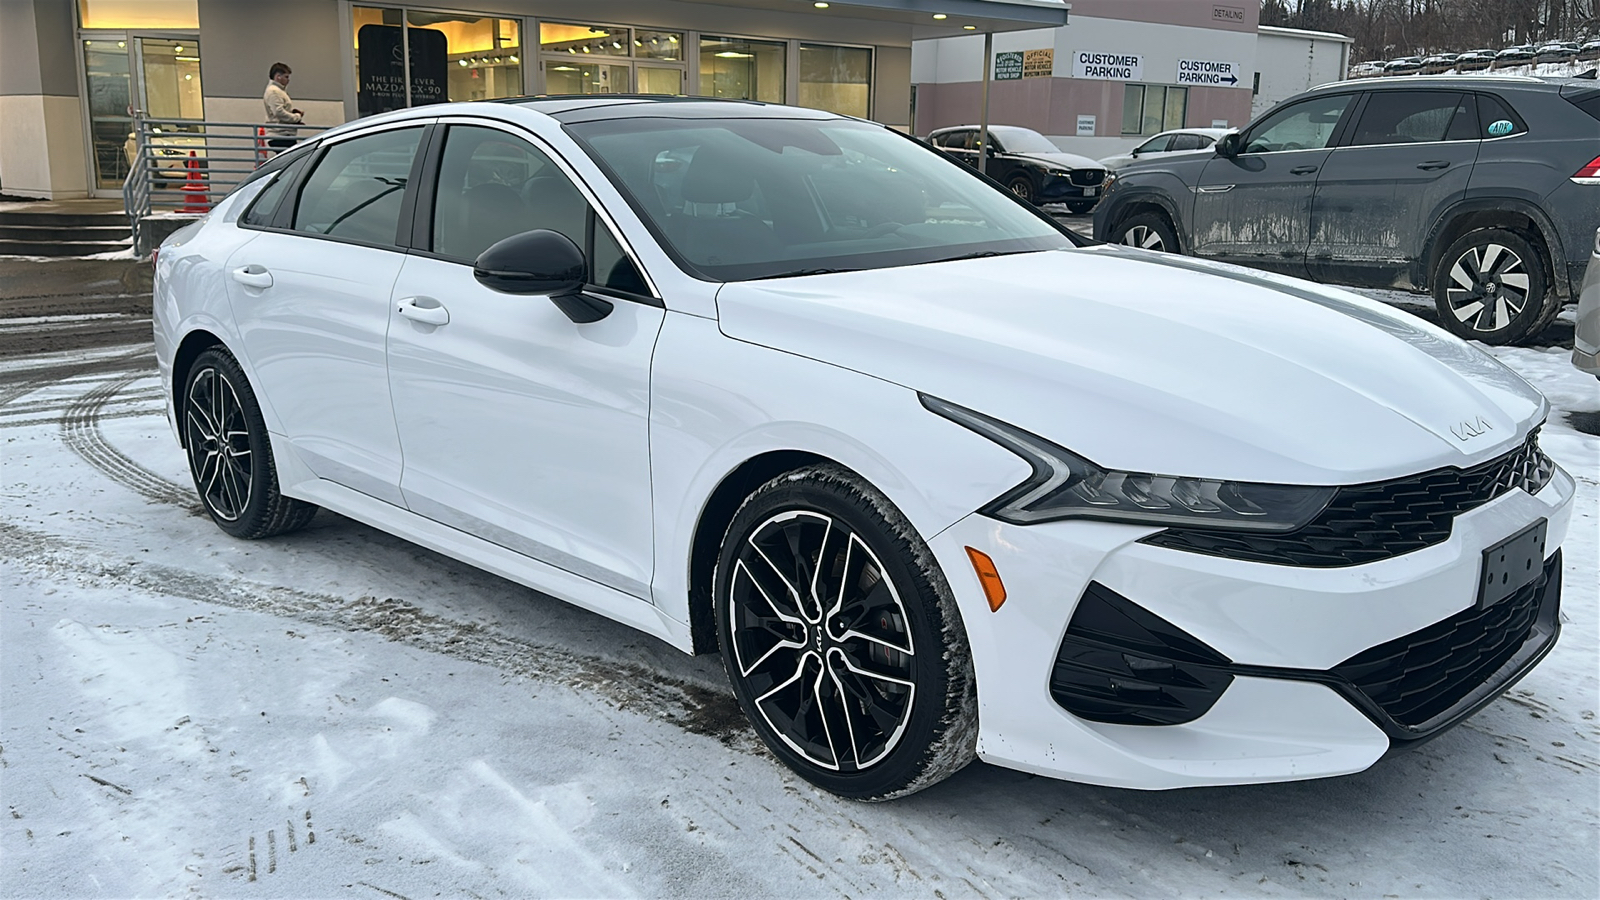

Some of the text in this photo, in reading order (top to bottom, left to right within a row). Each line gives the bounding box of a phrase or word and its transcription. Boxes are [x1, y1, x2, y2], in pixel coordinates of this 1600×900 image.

[1214, 8, 1243, 20] DETAILING
[1026, 50, 1052, 61] OFFICIAL
[1080, 53, 1138, 67] CUSTOMER
[1085, 66, 1131, 78] PARKING
[1180, 60, 1231, 73] CUSTOMER
[371, 75, 387, 83] THE
[1179, 72, 1219, 83] PARKING
[365, 83, 441, 95] MAZDA CX-90
[1493, 122, 1510, 133] ADK
